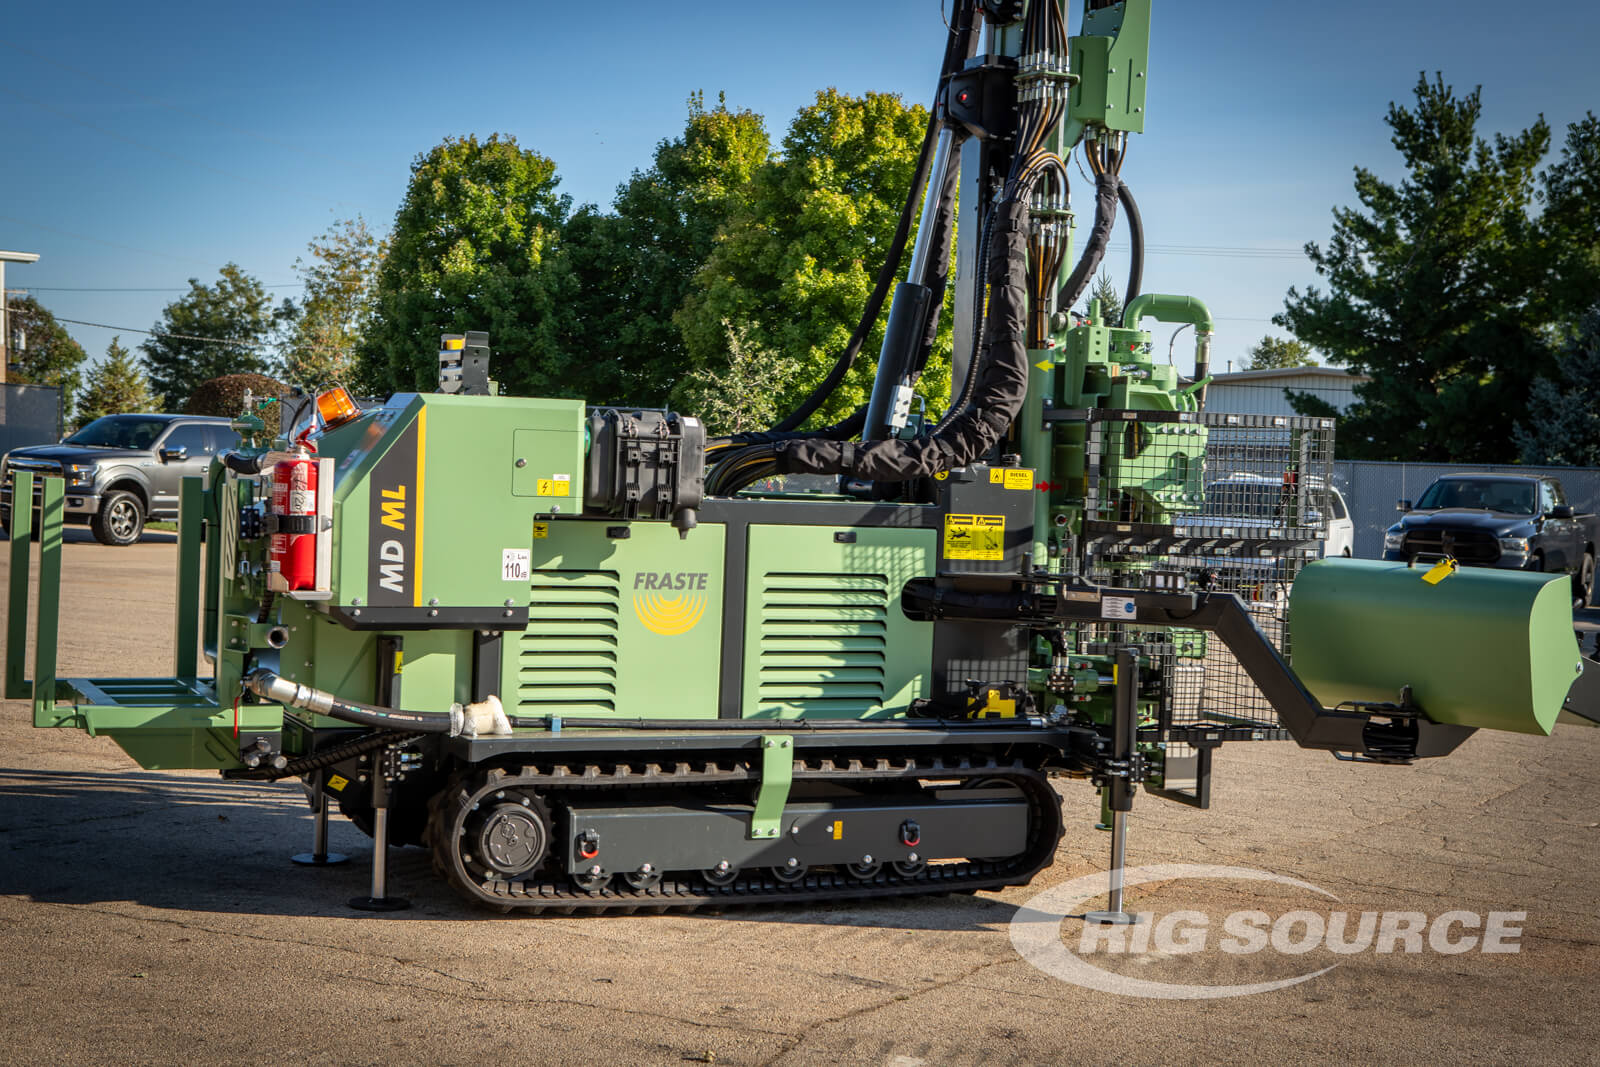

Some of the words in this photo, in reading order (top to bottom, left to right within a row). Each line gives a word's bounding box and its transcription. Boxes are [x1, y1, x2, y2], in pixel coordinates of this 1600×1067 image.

[381, 484, 407, 531] ML
[379, 540, 405, 593] MD
[504, 562, 521, 578] 110
[633, 572, 709, 590] FRASTE
